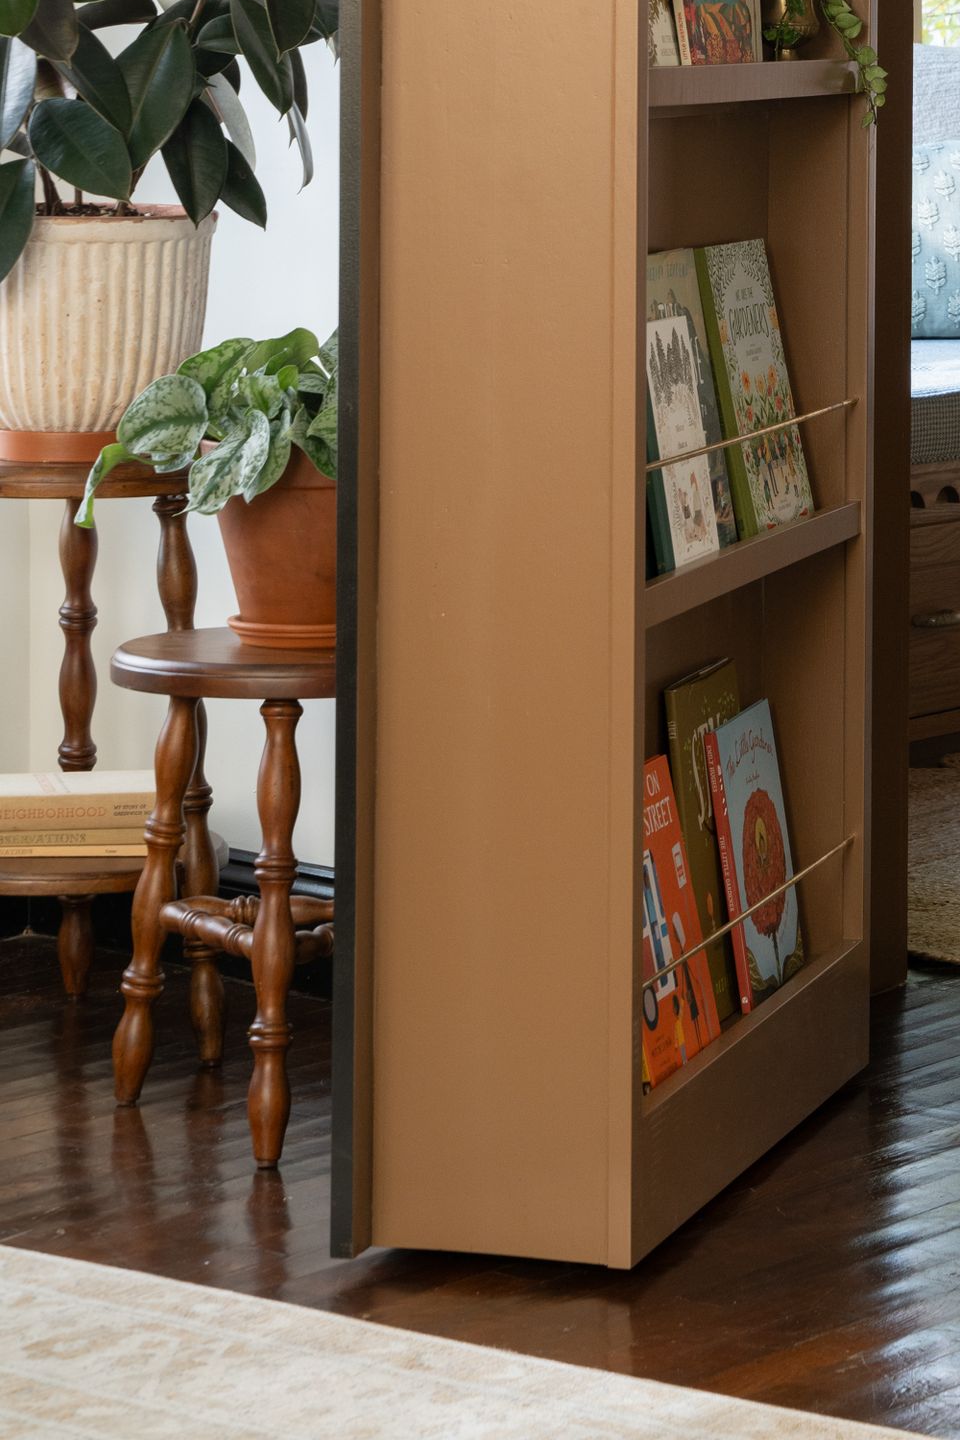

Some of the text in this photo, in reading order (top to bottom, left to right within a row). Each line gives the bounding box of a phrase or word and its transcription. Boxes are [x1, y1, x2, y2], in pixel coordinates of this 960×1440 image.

[646, 770, 661, 797] ON
[0, 807, 106, 820] EIGHBORHOOD
[643, 796, 673, 836] STREET
